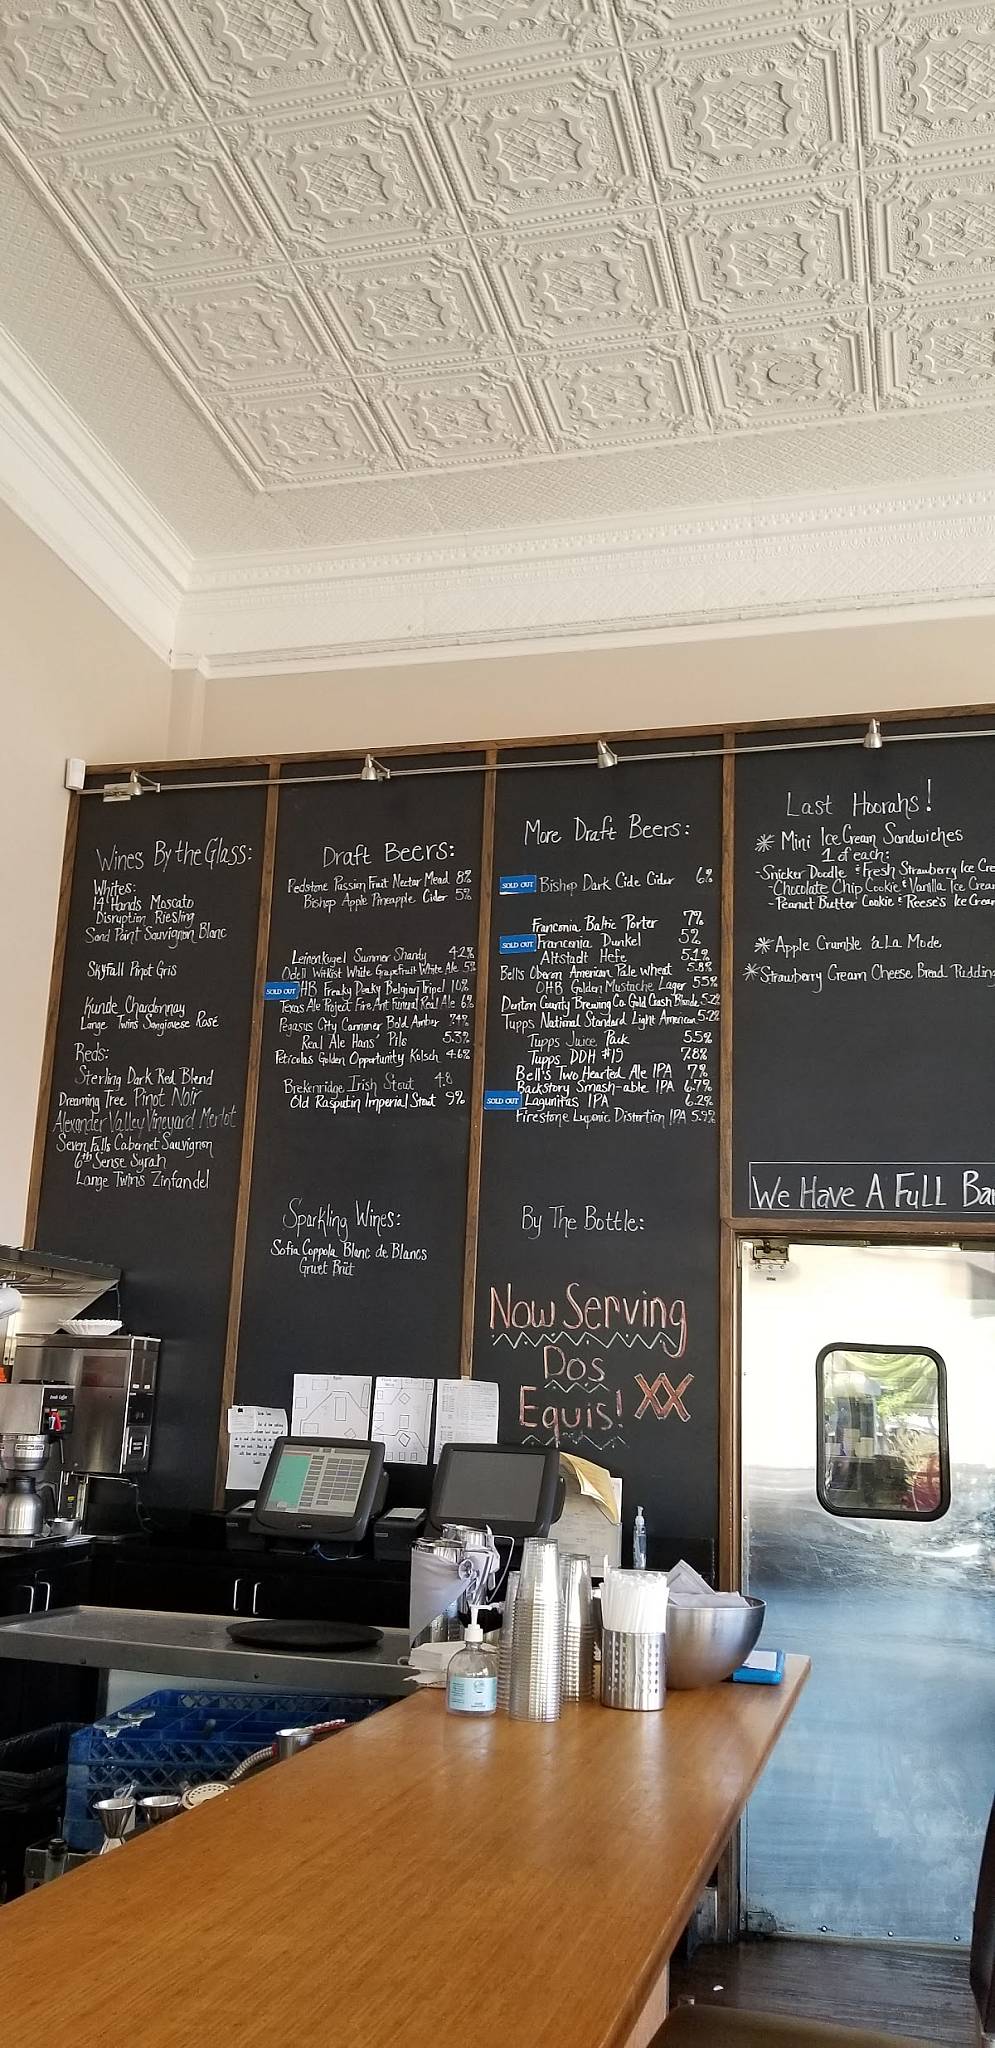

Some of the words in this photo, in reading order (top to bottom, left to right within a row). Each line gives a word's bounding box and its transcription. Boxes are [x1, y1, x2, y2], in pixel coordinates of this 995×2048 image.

[787, 792, 833, 816] Last
[525, 820, 562, 845] More
[574, 815, 617, 842] Draft
[782, 830, 811, 851] Mini
[821, 826, 841, 846] Ice
[843, 824, 876, 848] Cream
[97, 845, 144, 871] Wines
[154, 841, 171, 872] By
[323, 844, 371, 867] Draft
[822, 849, 835, 862] 1
[838, 847, 851, 861] of
[862, 861, 896, 878] Fresh
[960, 859, 975, 873] Ice
[368, 876, 389, 890] Fruit
[456, 870, 472, 884] 8%
[539, 877, 578, 896] Bishop
[582, 874, 612, 892] Dark
[647, 871, 676, 886] Cider
[695, 867, 713, 884] 6%
[832, 879, 863, 898] Chip
[865, 878, 900, 893] Cookie
[950, 882, 965, 893] Ice
[304, 894, 336, 913] Bishop
[341, 893, 368, 912] Apple
[423, 890, 448, 903] Cider
[456, 889, 472, 900] 5%
[818, 896, 857, 909] Butter
[862, 896, 894, 907] Cookie
[199, 922, 227, 939] Blanc
[584, 915, 617, 932] Baltic
[621, 914, 659, 930] Porter
[683, 910, 704, 926] 7%
[601, 932, 641, 947] Dunkel
[678, 928, 701, 945] 5%
[775, 936, 810, 958] Apple
[907, 934, 942, 949] Mode
[353, 948, 391, 963] Summer
[130, 961, 154, 980] Pinot
[156, 960, 177, 979] Gris
[569, 967, 613, 979] American
[615, 964, 637, 977] Pale
[828, 964, 867, 981] Cream
[872, 964, 913, 980] Cheese
[917, 962, 948, 978] Bread
[658, 976, 686, 995] Lager
[631, 1012, 656, 1030] Light
[302, 1035, 323, 1050] Real
[329, 1034, 345, 1048] Ale
[387, 1032, 407, 1046] Pils
[349, 1051, 405, 1069] Opportunity
[75, 1065, 121, 1091] Sterling
[127, 1066, 153, 1085] Dark
[155, 1068, 175, 1084] Red
[179, 1067, 214, 1085] Blend
[556, 1065, 578, 1080] Two
[582, 1066, 626, 1080] Hearted
[629, 1063, 648, 1075] Ale
[652, 1063, 673, 1079] IPA
[688, 1063, 708, 1078] 7%
[347, 1074, 377, 1095] Irish
[656, 1080, 675, 1093] IPA
[104, 1090, 127, 1108] Tree
[133, 1087, 165, 1109] Pinot
[172, 1087, 203, 1106] Noir
[290, 1095, 309, 1109] Old
[365, 1093, 408, 1114] Imperial
[446, 1091, 465, 1106] 9%
[588, 1094, 609, 1108] IPA
[516, 1107, 568, 1127] Firestone
[94, 1153, 127, 1169] Sense
[151, 1170, 209, 1190] Zinfandel
[752, 1176, 790, 1209] We
[800, 1176, 856, 1209] Have
[865, 1173, 884, 1209] A
[282, 1197, 348, 1242] Sparkling
[522, 1205, 542, 1239] By
[549, 1206, 577, 1238] The
[343, 1242, 371, 1259] Blanc
[375, 1244, 388, 1258] de
[489, 1283, 555, 1329] Now
[563, 1283, 688, 1358] Serving
[544, 1345, 605, 1382] Dos
